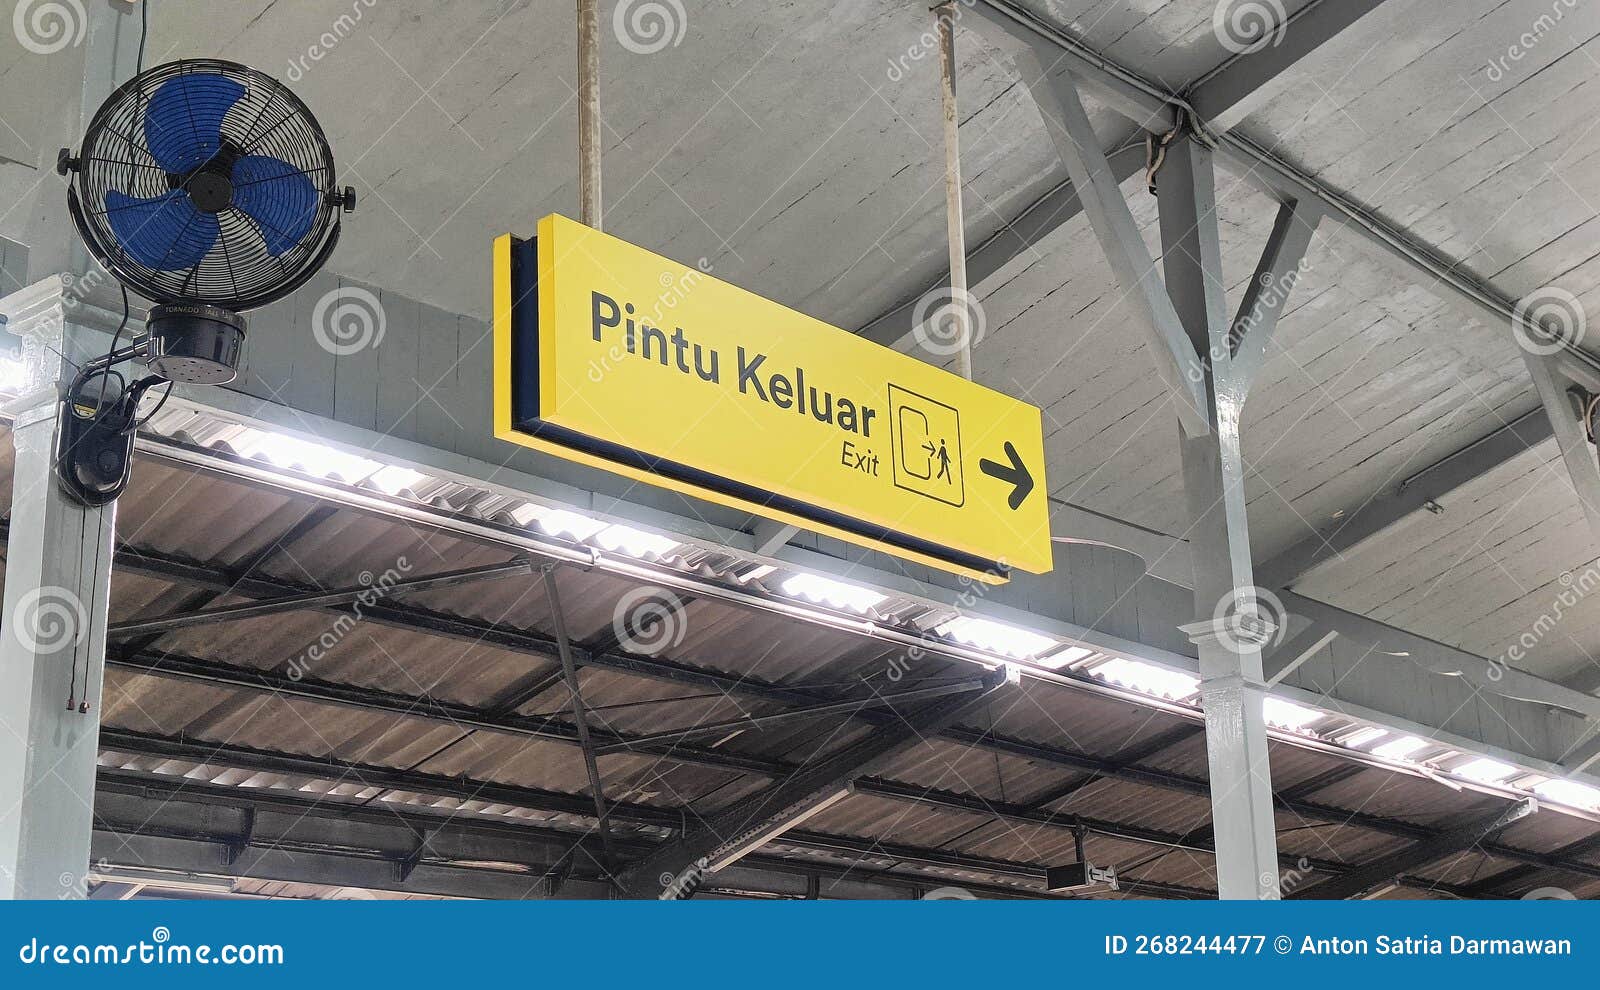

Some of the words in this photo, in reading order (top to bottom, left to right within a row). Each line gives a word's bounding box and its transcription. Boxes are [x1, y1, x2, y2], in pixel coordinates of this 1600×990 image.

[591, 290, 720, 385] Pintu
[737, 346, 876, 438] Keluar
[841, 441, 880, 477] Exit
